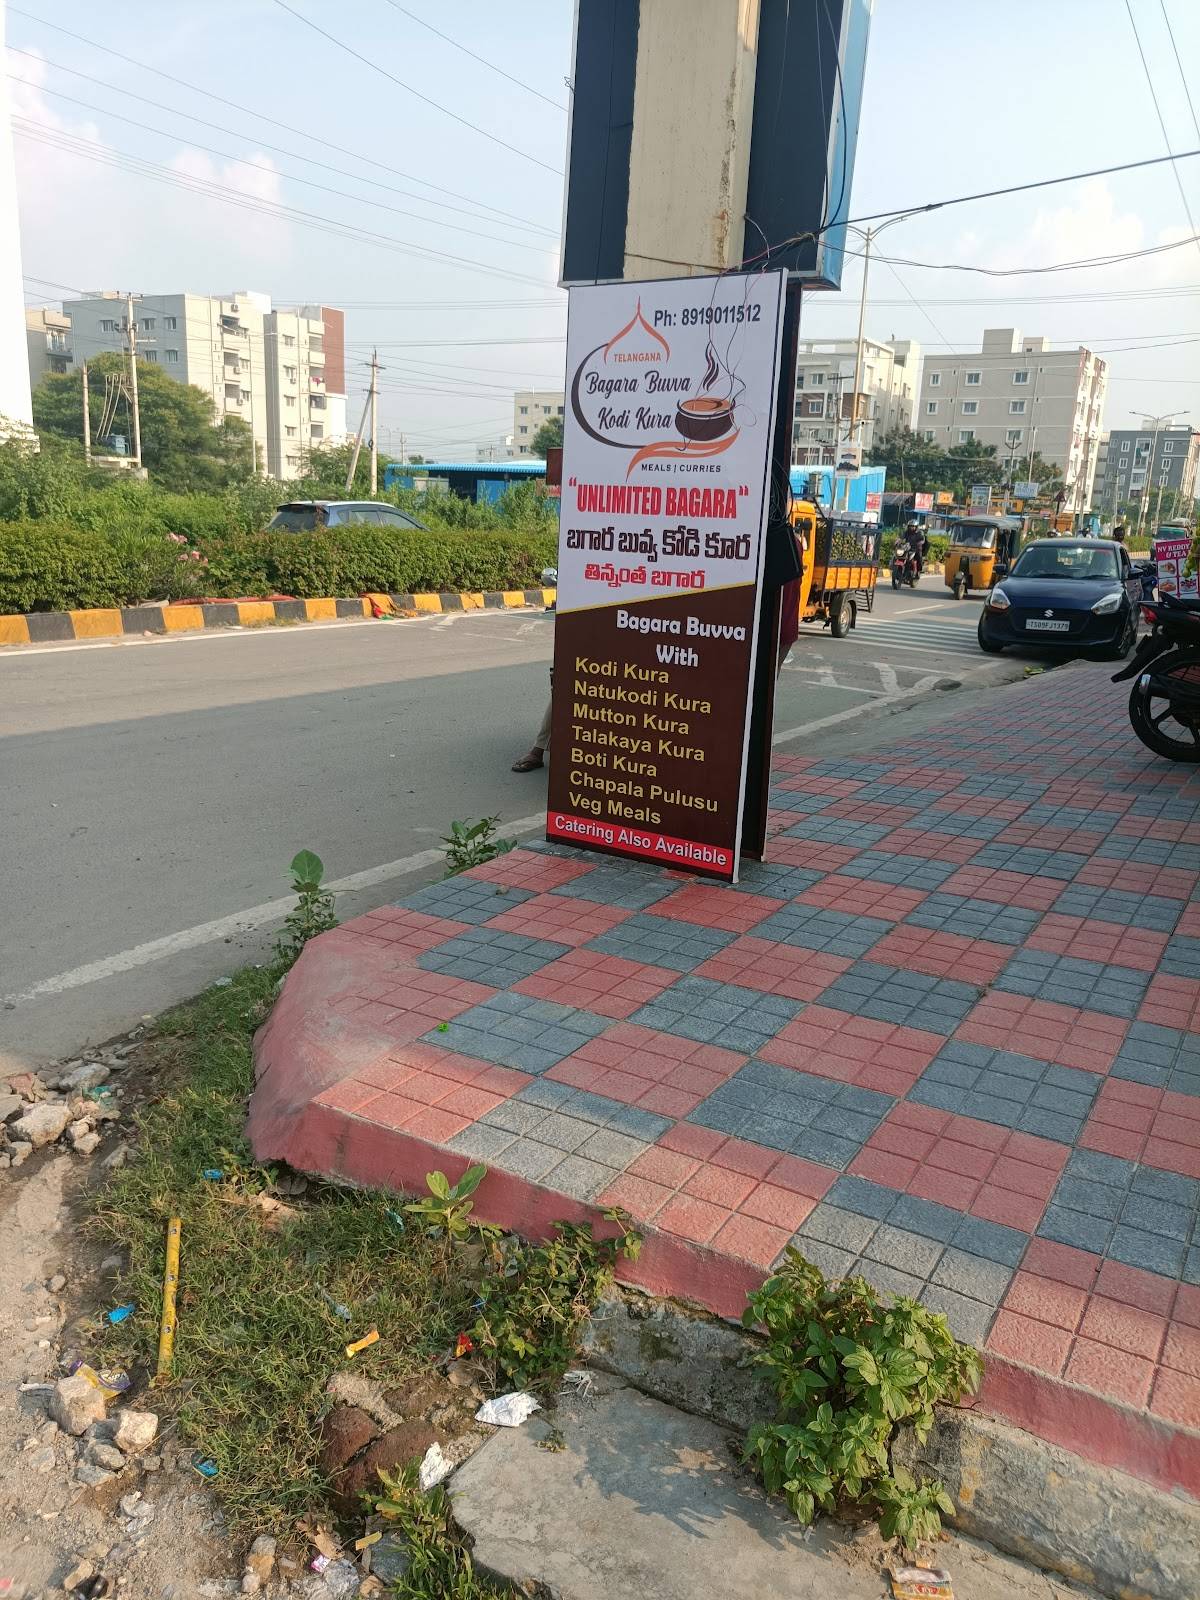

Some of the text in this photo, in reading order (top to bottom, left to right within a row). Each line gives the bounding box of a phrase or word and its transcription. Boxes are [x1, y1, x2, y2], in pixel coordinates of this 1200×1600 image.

[654, 304, 761, 327] Ph: 8919011512
[614, 353, 661, 363] TELANGANA
[585, 370, 691, 399] Bagara Buvva
[598, 406, 673, 430] Kodi Kura
[641, 463, 671, 472] MEALS
[679, 464, 721, 473] CURRIES
[566, 525, 751, 563] బగార బువ్వ కోడి కూర
[651, 569, 706, 589] బగార
[617, 609, 746, 641] Bagara Buvva
[656, 644, 699, 667] With
[575, 657, 670, 684] Kodi Kura
[574, 680, 712, 714] Natukodi Kura
[573, 703, 689, 735] Mutton Kura
[572, 725, 705, 761] Talakaya Kura
[571, 748, 657, 777] Boti Kura
[570, 770, 718, 812] Chapala Pulusu
[568, 792, 662, 825] Veg Meals
[555, 815, 727, 866] Catering Also Available
